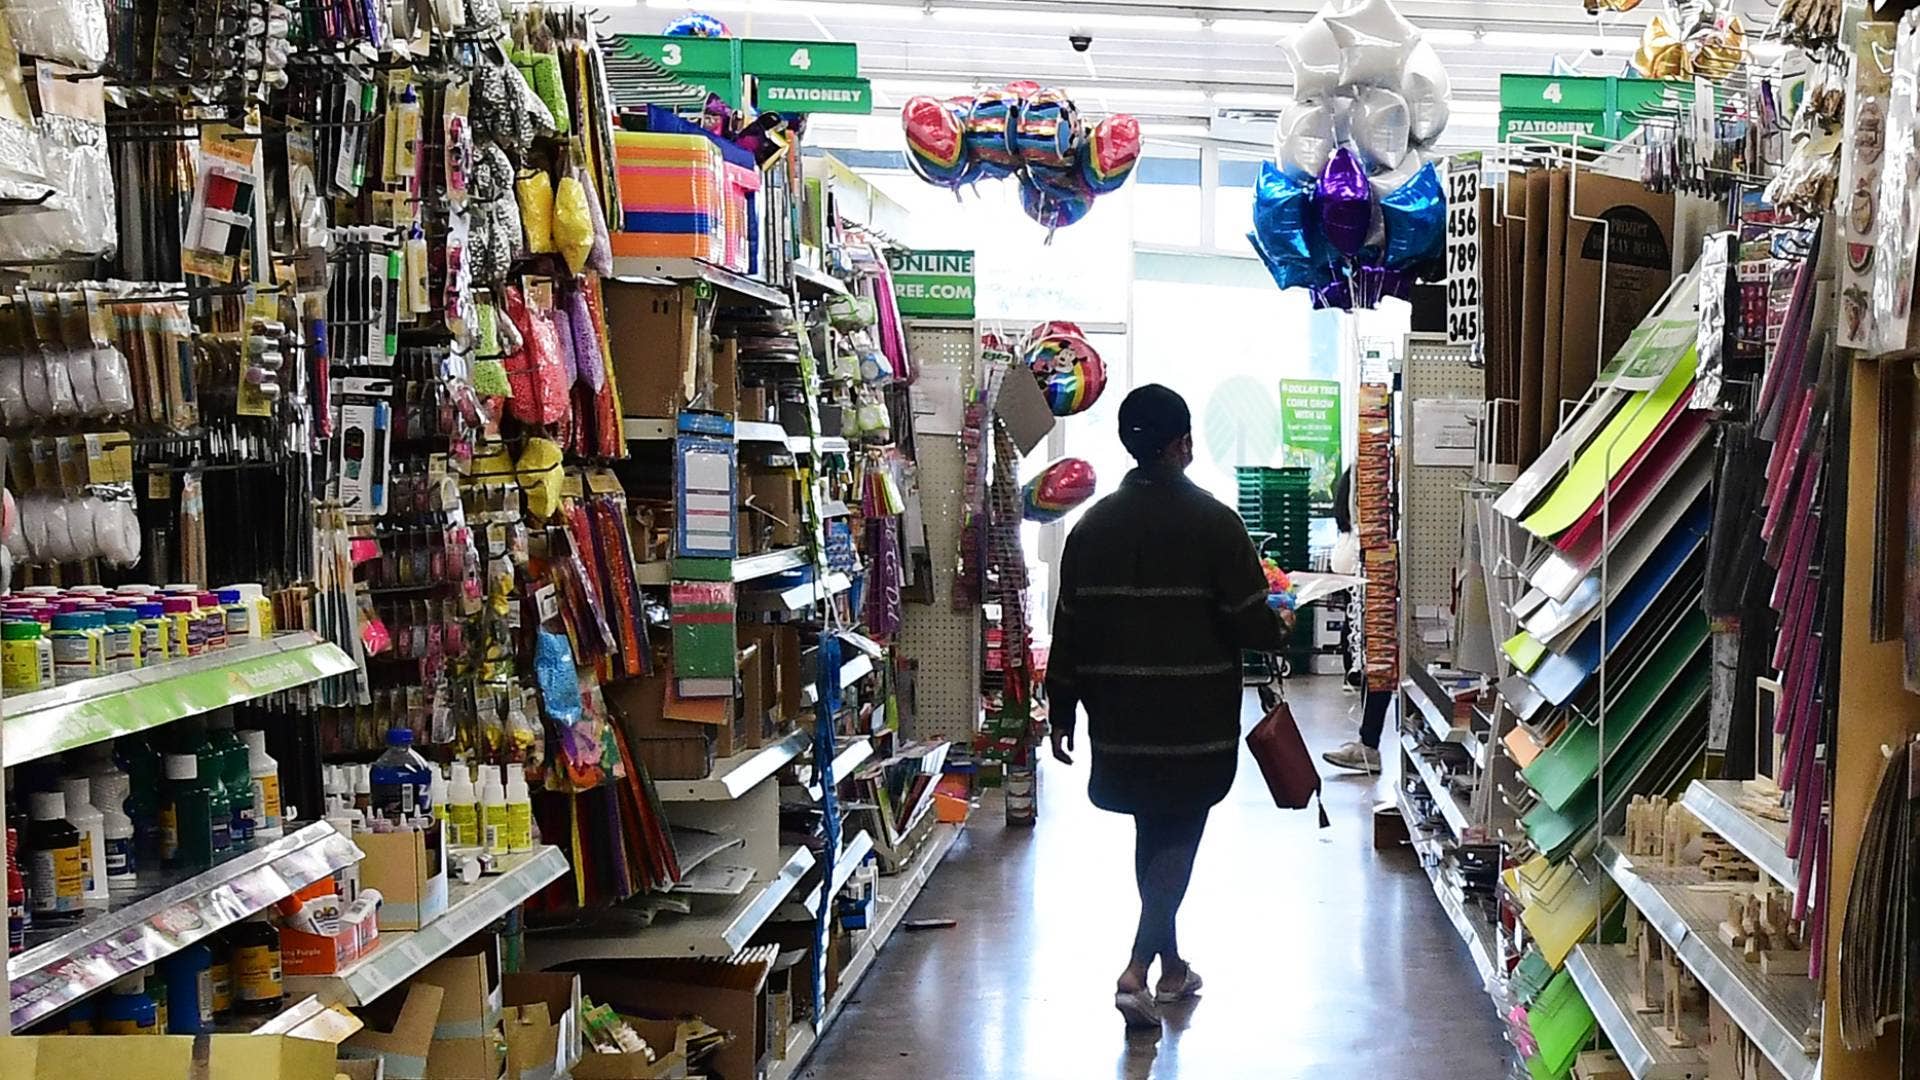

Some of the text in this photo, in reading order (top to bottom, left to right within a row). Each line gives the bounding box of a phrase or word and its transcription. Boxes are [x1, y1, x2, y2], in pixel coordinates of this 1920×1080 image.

[662, 44, 682, 66] 3
[789, 48, 811, 70] 4
[768, 86, 862, 102] STATIONERY
[1542, 83, 1562, 104] 4
[1508, 120, 1595, 134] STATIONERY
[1449, 173, 1477, 205] 123
[1448, 207, 1477, 238] 456
[892, 255, 971, 273] ONLINE
[1449, 242, 1477, 273] 789
[896, 284, 972, 299] REE.COM
[1449, 277, 1477, 308] 012
[1449, 311, 1477, 342] 345
